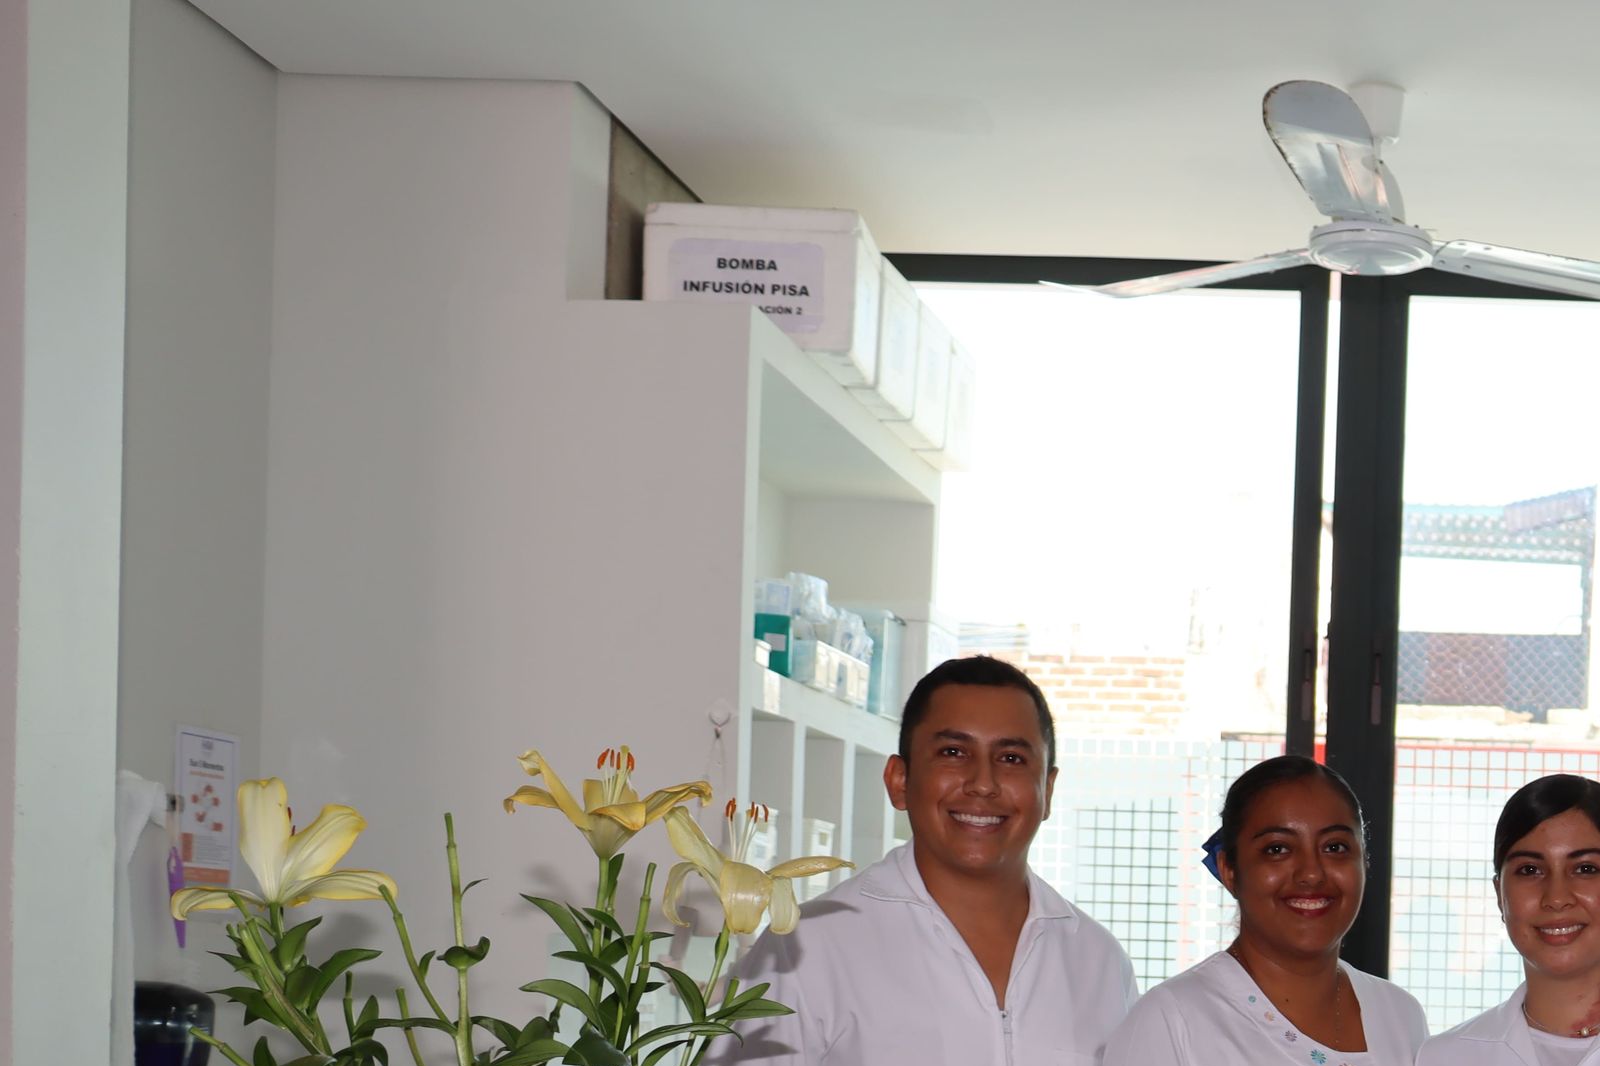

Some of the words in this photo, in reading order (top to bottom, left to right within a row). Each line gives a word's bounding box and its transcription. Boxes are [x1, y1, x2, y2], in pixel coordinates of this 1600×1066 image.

[716, 257, 778, 271] BOMBA
[770, 283, 811, 297] PISA
[795, 307, 803, 315] 2
